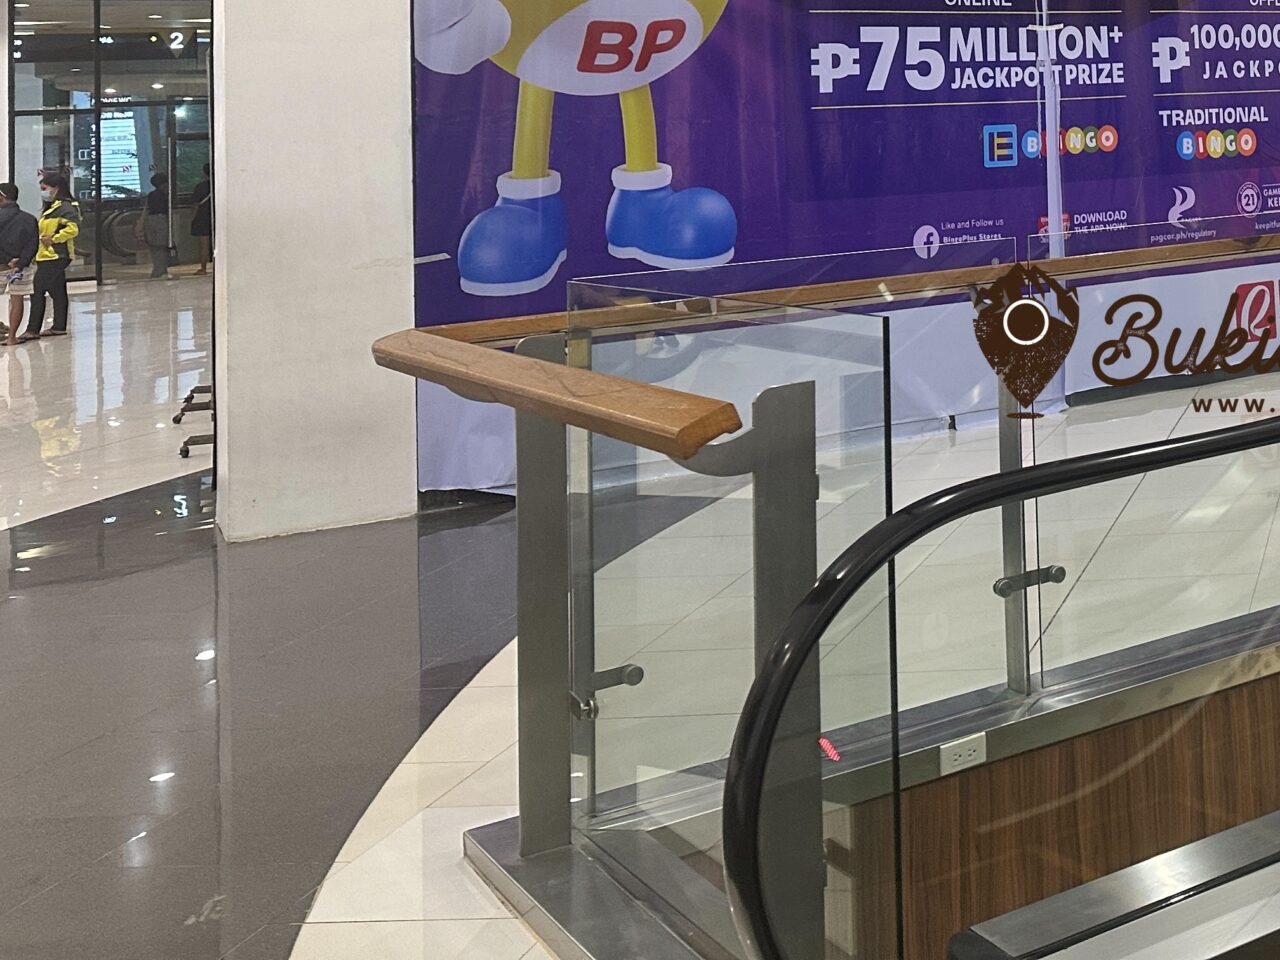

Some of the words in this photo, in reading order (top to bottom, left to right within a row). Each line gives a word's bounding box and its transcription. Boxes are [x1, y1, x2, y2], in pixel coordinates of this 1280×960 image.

[169, 31, 184, 49] 2
[576, 18, 687, 74] BP
[1065, 62, 1125, 86] PRIZE
[1158, 106, 1269, 127] TRADITIONAL
[1180, 132, 1254, 156] BINGO
[1243, 193, 1255, 207] 21
[1263, 187, 1280, 197] GAME
[941, 221, 956, 230] Like
[957, 220, 969, 229] and
[971, 218, 993, 228] Follow
[995, 218, 1004, 226] us
[1073, 209, 1127, 225] DOWNLOAD
[979, 233, 1002, 241] Stores
[1074, 225, 1088, 234] THE
[1090, 224, 1104, 232] APP
[1150, 228, 1217, 244] pagcor.ph/regulatory
